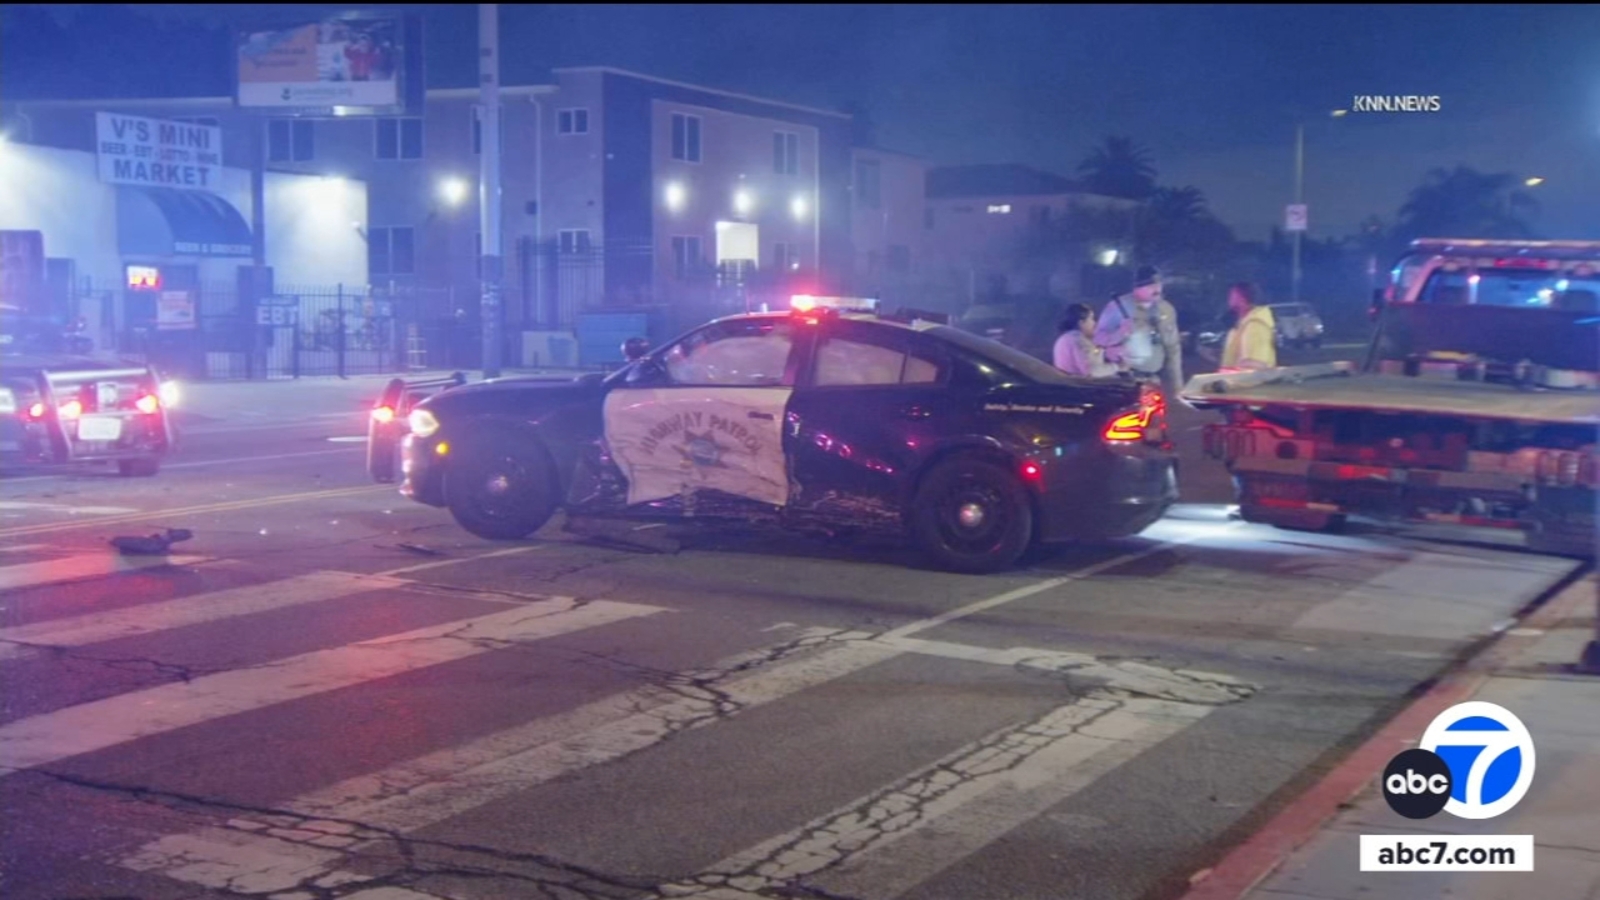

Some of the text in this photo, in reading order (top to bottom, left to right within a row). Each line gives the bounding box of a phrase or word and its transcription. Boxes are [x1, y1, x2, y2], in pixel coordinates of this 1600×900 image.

[111, 118, 209, 149] V'S MINI
[114, 159, 209, 186] MARKET
[257, 304, 298, 325] EBT
